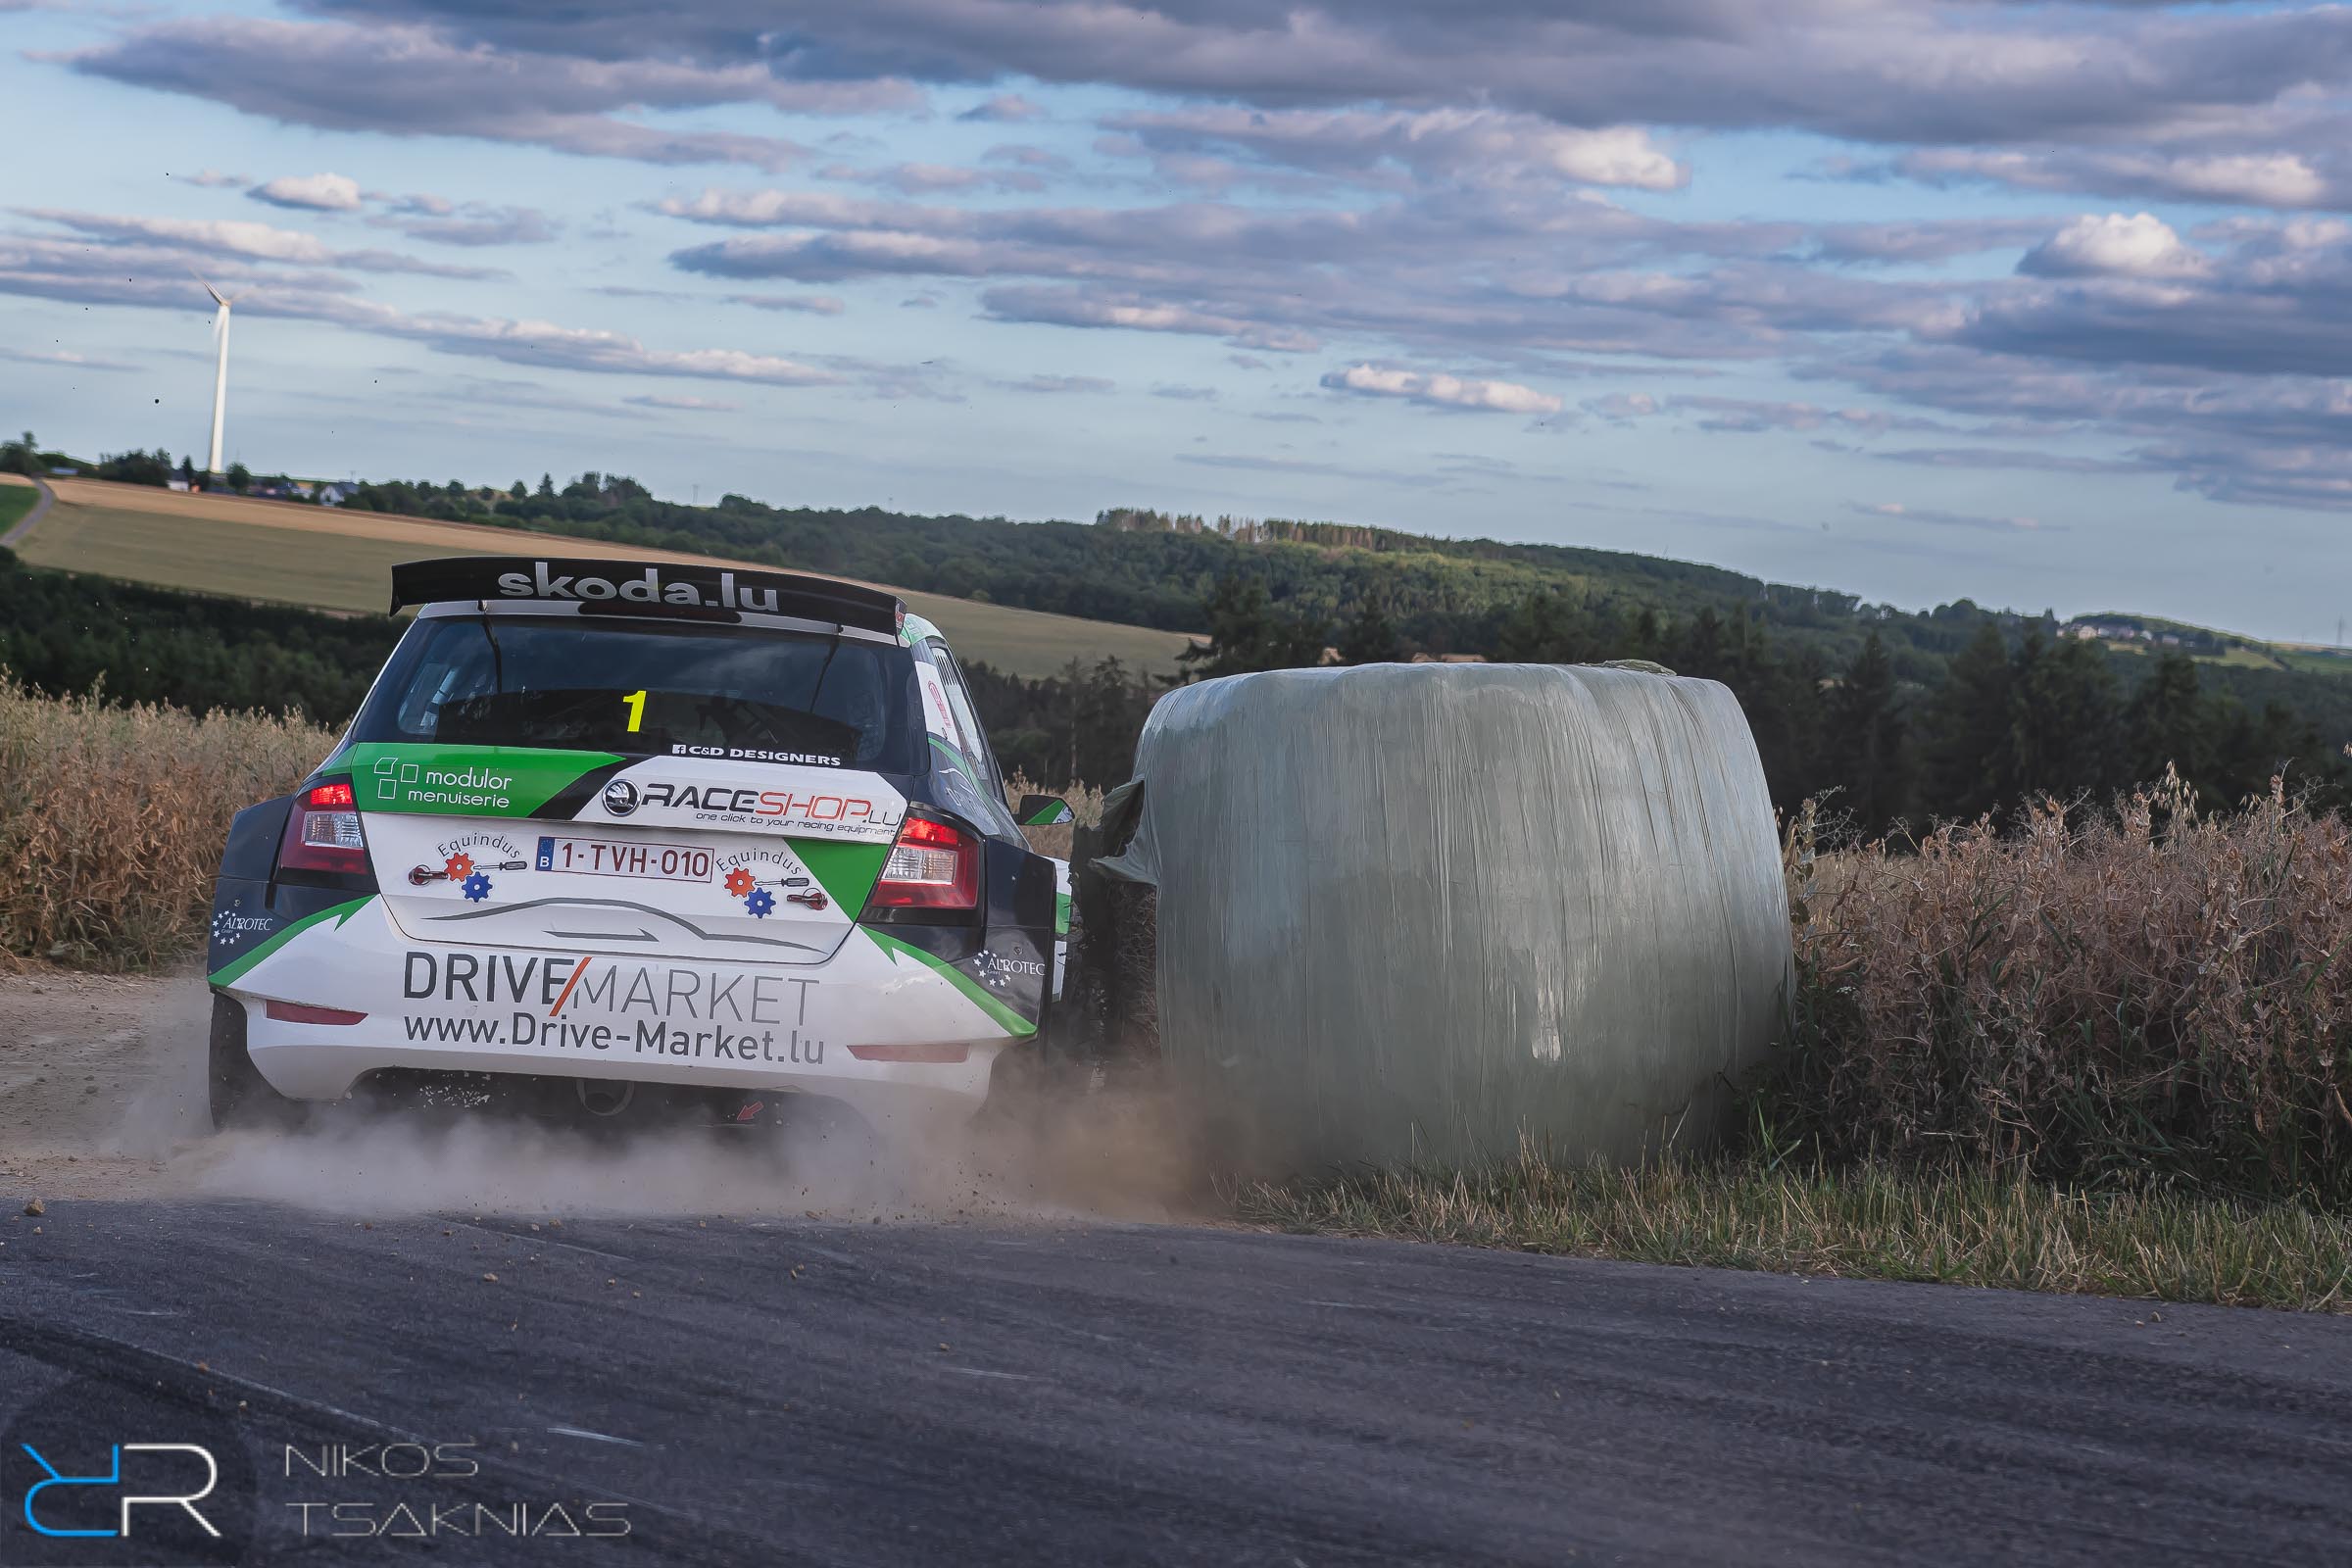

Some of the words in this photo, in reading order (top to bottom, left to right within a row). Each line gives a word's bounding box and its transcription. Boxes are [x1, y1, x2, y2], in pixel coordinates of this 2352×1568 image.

[498, 562, 778, 612] skoda.lu
[622, 690, 647, 732] 1
[689, 746, 724, 756] C&D
[730, 748, 841, 766] DESIGNERS
[425, 767, 513, 790] modulor
[408, 788, 510, 808] menuiserie
[696, 812, 719, 821] one
[720, 812, 747, 823] click
[751, 815, 763, 825] to
[798, 820, 834, 832] racing
[837, 823, 896, 837] equipment
[437, 833, 520, 858] Equindus
[539, 856, 550, 867] B
[563, 843, 709, 877] 1-TVH-010
[715, 847, 802, 876] Equindus
[404, 1011, 824, 1064] www.Drive-Market.lu
